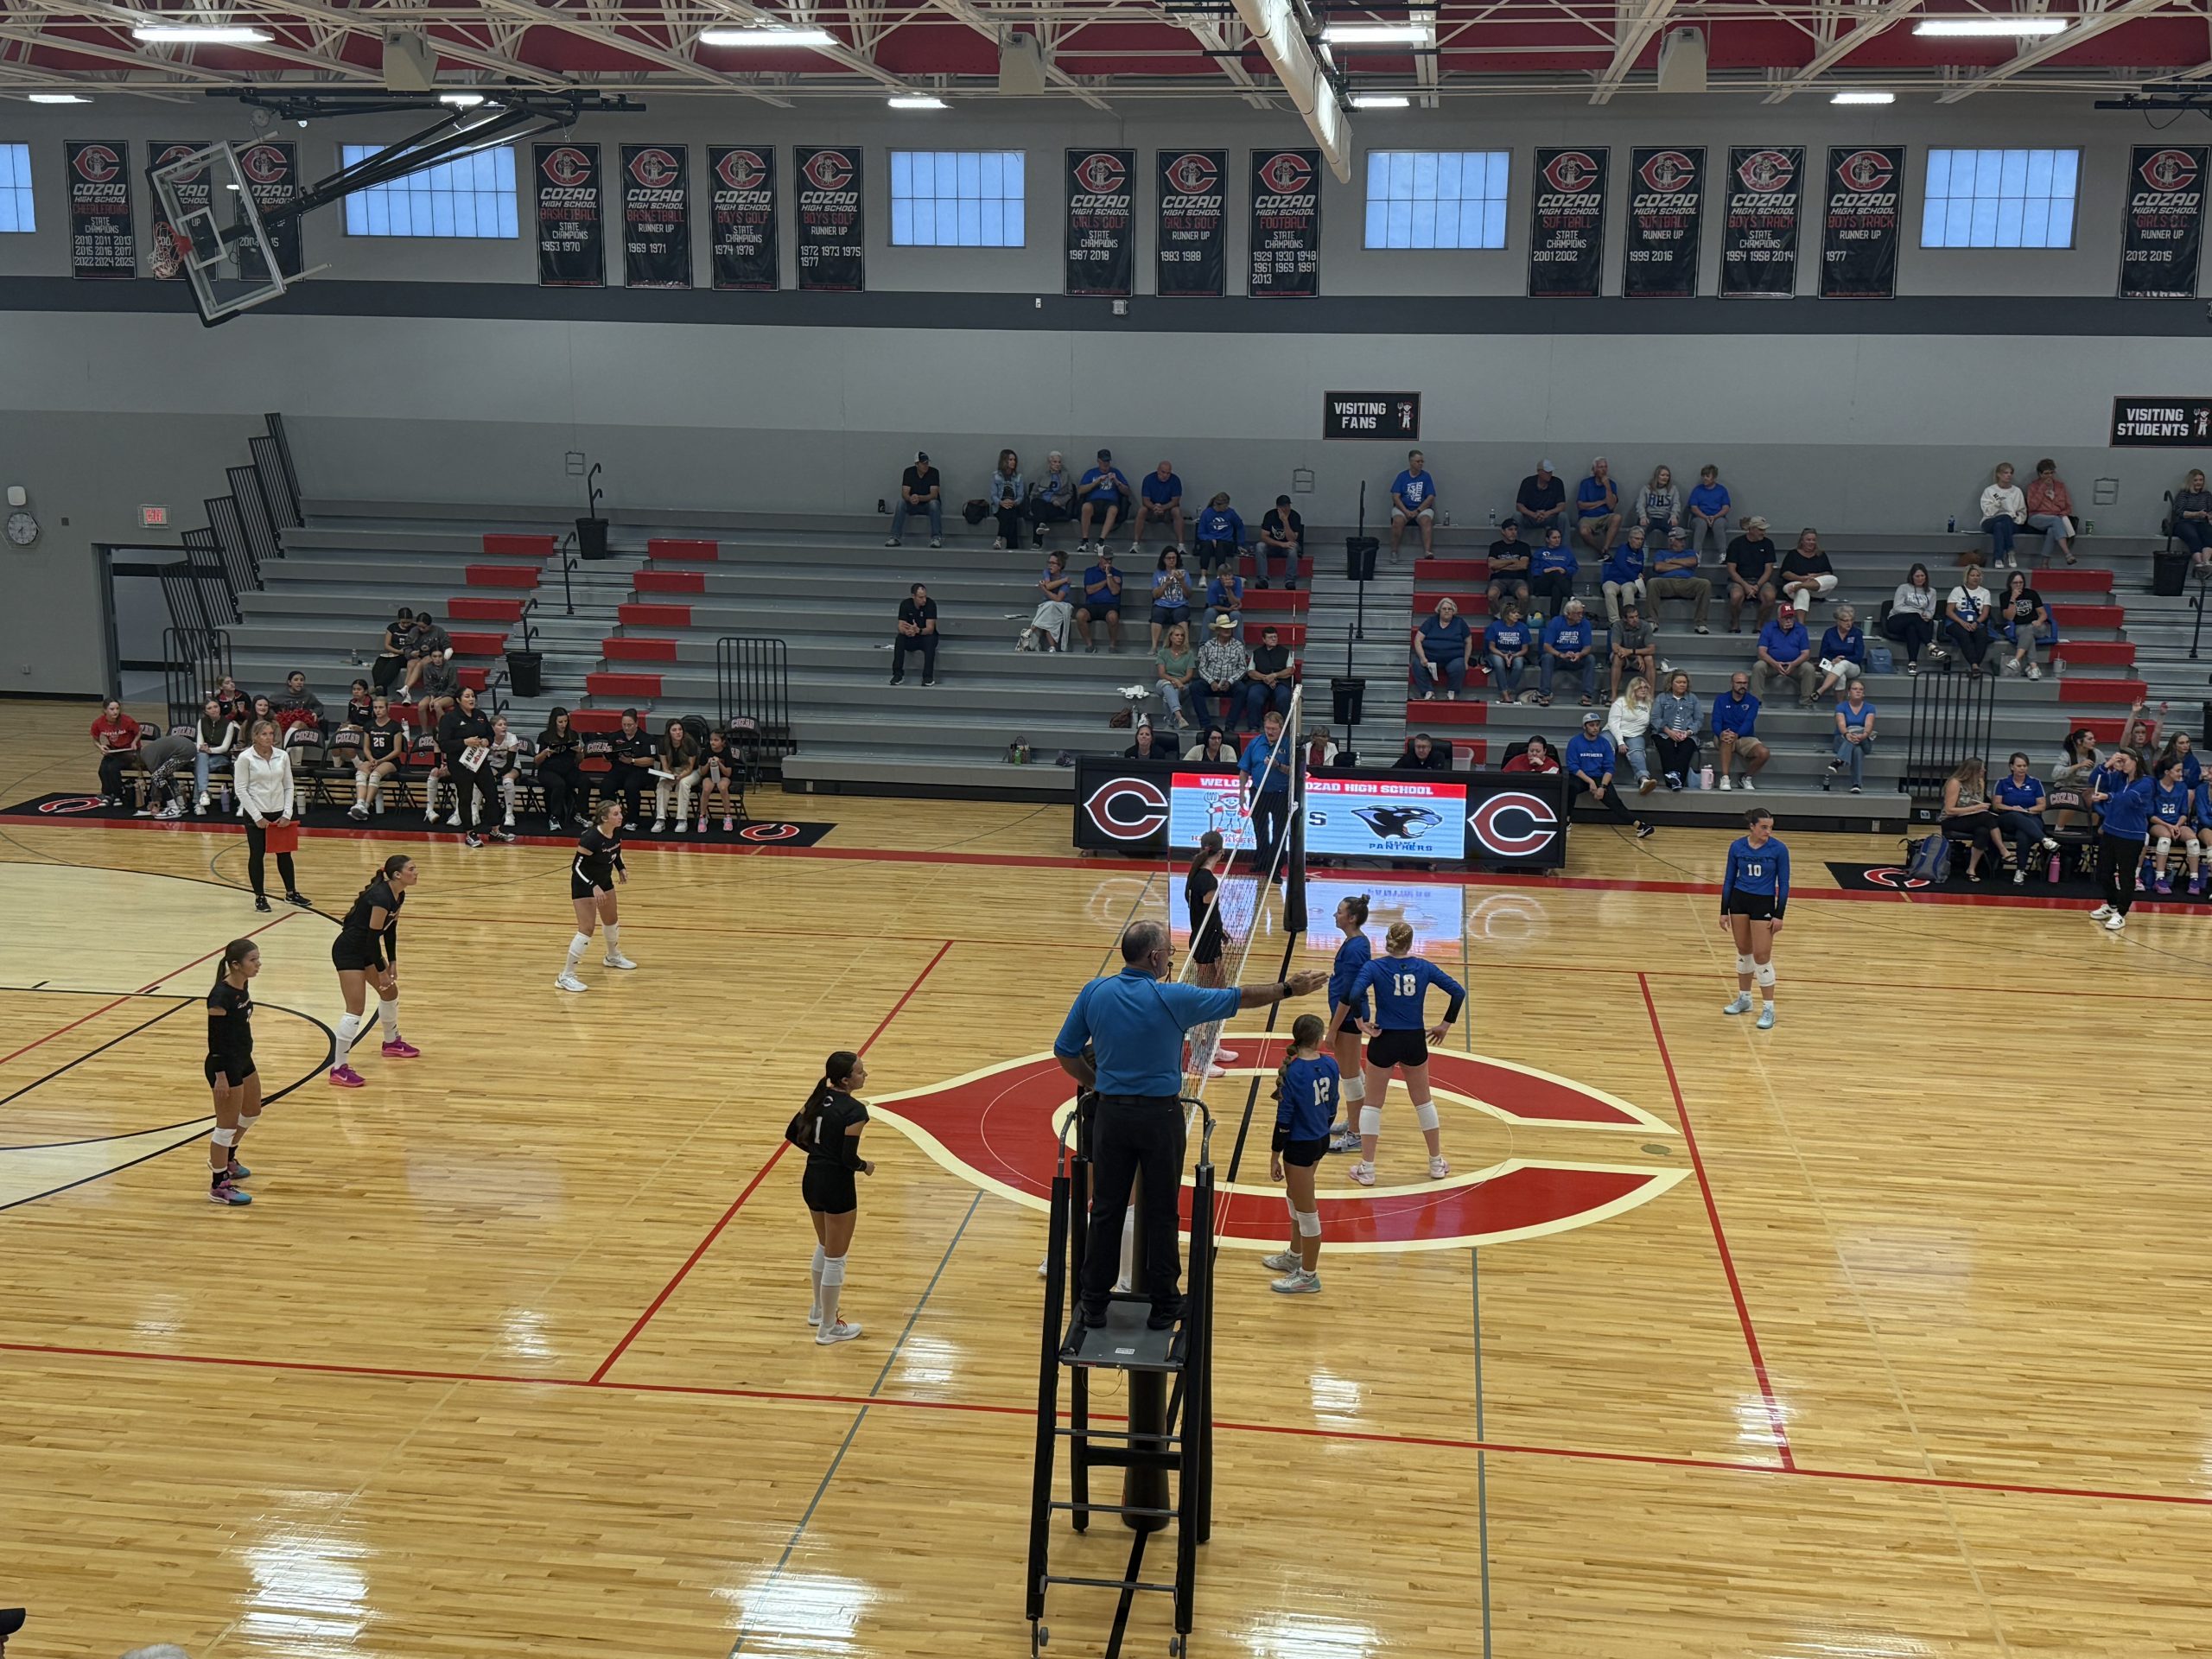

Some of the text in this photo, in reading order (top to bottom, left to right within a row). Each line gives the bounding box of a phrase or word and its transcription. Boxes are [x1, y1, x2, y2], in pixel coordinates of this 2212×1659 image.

[73, 184, 125, 195] COZAD
[541, 188, 596, 200] COZAD
[627, 189, 684, 201] COZAD
[715, 191, 772, 203] COZAD
[800, 192, 858, 204] COZAD
[1071, 195, 1130, 207] COZAD
[1162, 196, 1222, 207] COZAD
[1255, 195, 1315, 208] COZAD
[1538, 194, 1601, 207] COZAD
[1634, 194, 1698, 207] COZAD
[1732, 194, 1796, 207] COZAD
[1830, 194, 1896, 207] COZAD
[2132, 194, 2200, 206] COZAD
[73, 204, 128, 214] CHEERLEADING
[540, 209, 597, 220] BASKETBALL
[626, 209, 684, 222] BASKETBALL
[718, 212, 767, 224] BOYS GOLF
[804, 213, 854, 225] BOYS GOLF
[91, 217, 110, 226] STATE
[560, 222, 579, 231] STATE
[1072, 217, 1126, 229] GIRLS GOLF
[1165, 217, 1217, 229] GIRLS GOLF
[1261, 217, 1307, 229] FOOTBALL
[1542, 216, 1592, 228] SOFTBALL
[1638, 217, 1688, 228] SOFTBALL
[1728, 216, 1794, 228] BOYS TRACK
[1828, 216, 1894, 227] BOYS TRACK
[2137, 216, 2167, 227] GIRLS
[639, 224, 664, 232] RUNNER
[733, 226, 753, 234] STATE
[811, 226, 847, 235] RUNNER UP
[553, 231, 588, 239] CHAMPIONS
[726, 234, 762, 243] CHAMPIONS
[1201, 232, 1210, 240] UP
[1643, 230, 1683, 239] RUNNER UP
[1750, 231, 1771, 239] STATE
[1871, 231, 1881, 239] UP
[2141, 230, 2171, 238] RUNNER
[75, 236, 130, 245] 2010 2011 2013
[1081, 239, 1118, 248] CHAMPIONS
[1265, 240, 1303, 249] CHAMPIONS
[1547, 239, 1586, 248] CHAMPIONS
[1739, 239, 1780, 248] CHAMPIONS
[76, 246, 130, 256] 2015 2016 2017
[563, 242, 580, 251] 1970
[628, 243, 666, 253] 1969 1971
[715, 245, 753, 255] 1974 1978
[801, 245, 861, 257] 1972 1973 1975
[75, 257, 133, 266] 2022 2024 2025
[801, 257, 819, 266] 1977
[1161, 251, 1201, 261] 1983 1988
[1253, 251, 1272, 261] 1929
[1275, 251, 1294, 261] 1930
[1534, 251, 1578, 261] 2001 2002
[1630, 251, 1673, 261] 1999 2016
[1772, 251, 1794, 261] 2014
[1827, 251, 1847, 261] 1977
[2126, 251, 2172, 262] 2012 2015
[1254, 263, 1315, 272] 1961 1969 1991
[1253, 274, 1272, 283] 2013
[1334, 403, 1386, 415] VISITING
[2126, 409, 2184, 421] VISITING
[1342, 416, 1376, 429] FANS
[2117, 423, 2189, 435] STUDENTS
[295, 731, 318, 742] COZAD
[336, 733, 359, 744] COZAD
[373, 737, 385, 747] 26
[1306, 782, 1433, 795] OZAD HIGH SCHOOL
[2050, 792, 2078, 805] COZAD
[2162, 804, 2175, 813] 22
[1748, 864, 1761, 876] 10
[1394, 974, 1415, 996] 18
[1313, 1077, 1330, 1106] 12
[815, 1116, 823, 1144] 1
